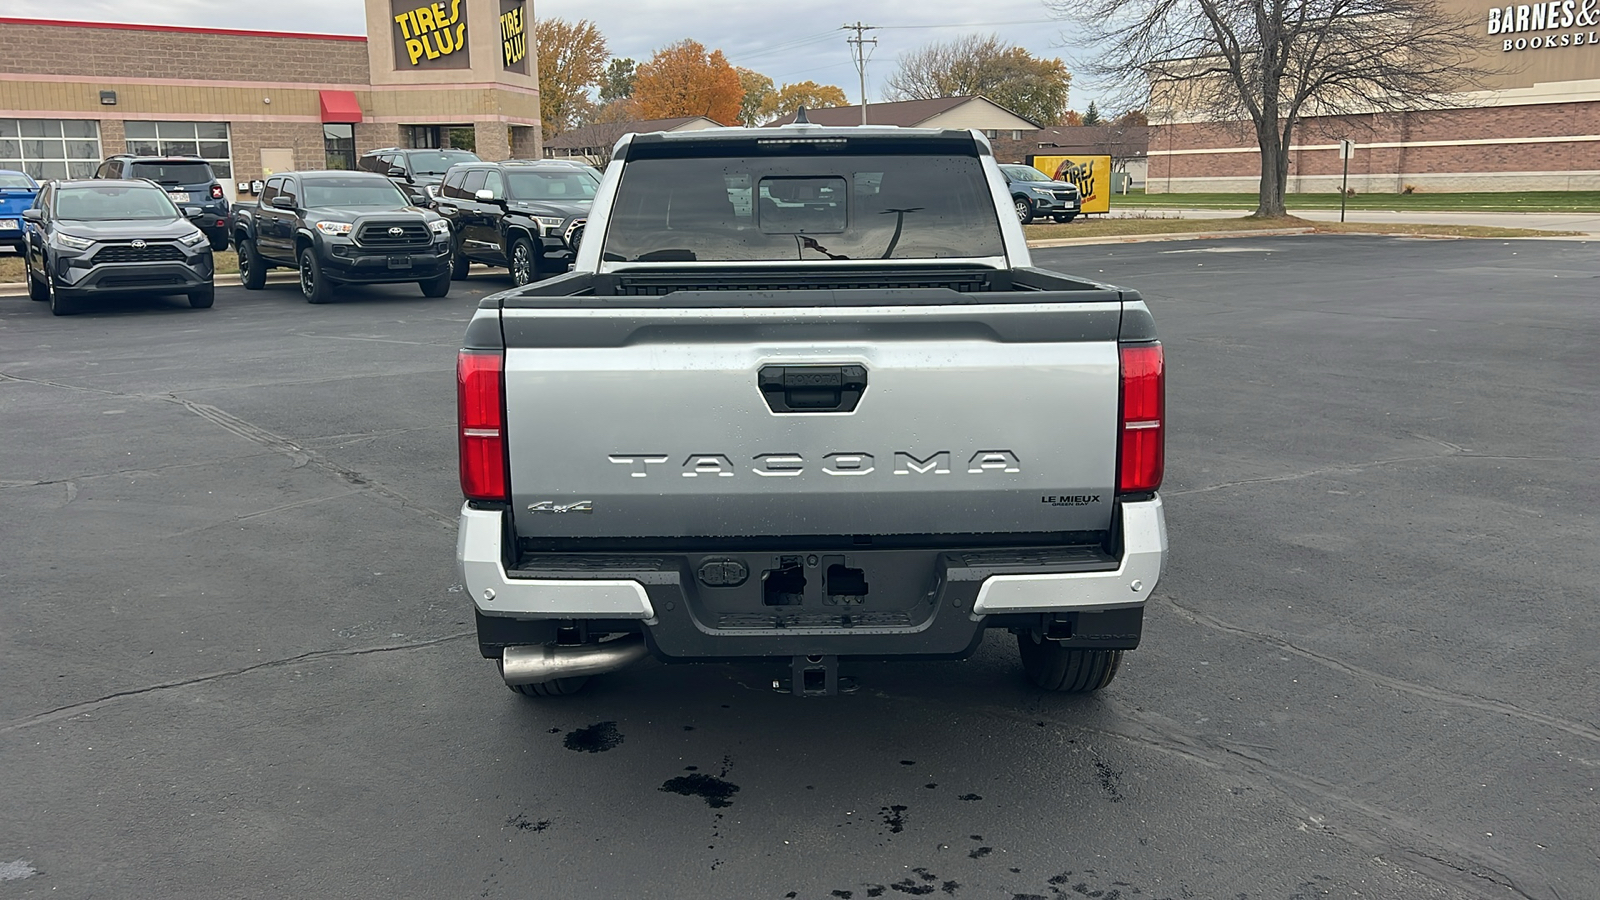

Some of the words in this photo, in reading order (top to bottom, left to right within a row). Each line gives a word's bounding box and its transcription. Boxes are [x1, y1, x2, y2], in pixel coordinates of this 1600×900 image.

[395, 0, 461, 40] TIRES
[500, 6, 524, 41] TIRES
[405, 23, 466, 66] PLUS
[504, 33, 526, 67] PLUS
[1502, 31, 1599, 52] BOOKSEL
[1062, 159, 1094, 186] TIRES
[1079, 177, 1095, 198] US
[787, 374, 839, 384] TOYOTA
[608, 450, 1020, 478] TACOMA
[1041, 495, 1057, 503] LE
[1060, 494, 1100, 503] MIEUX
